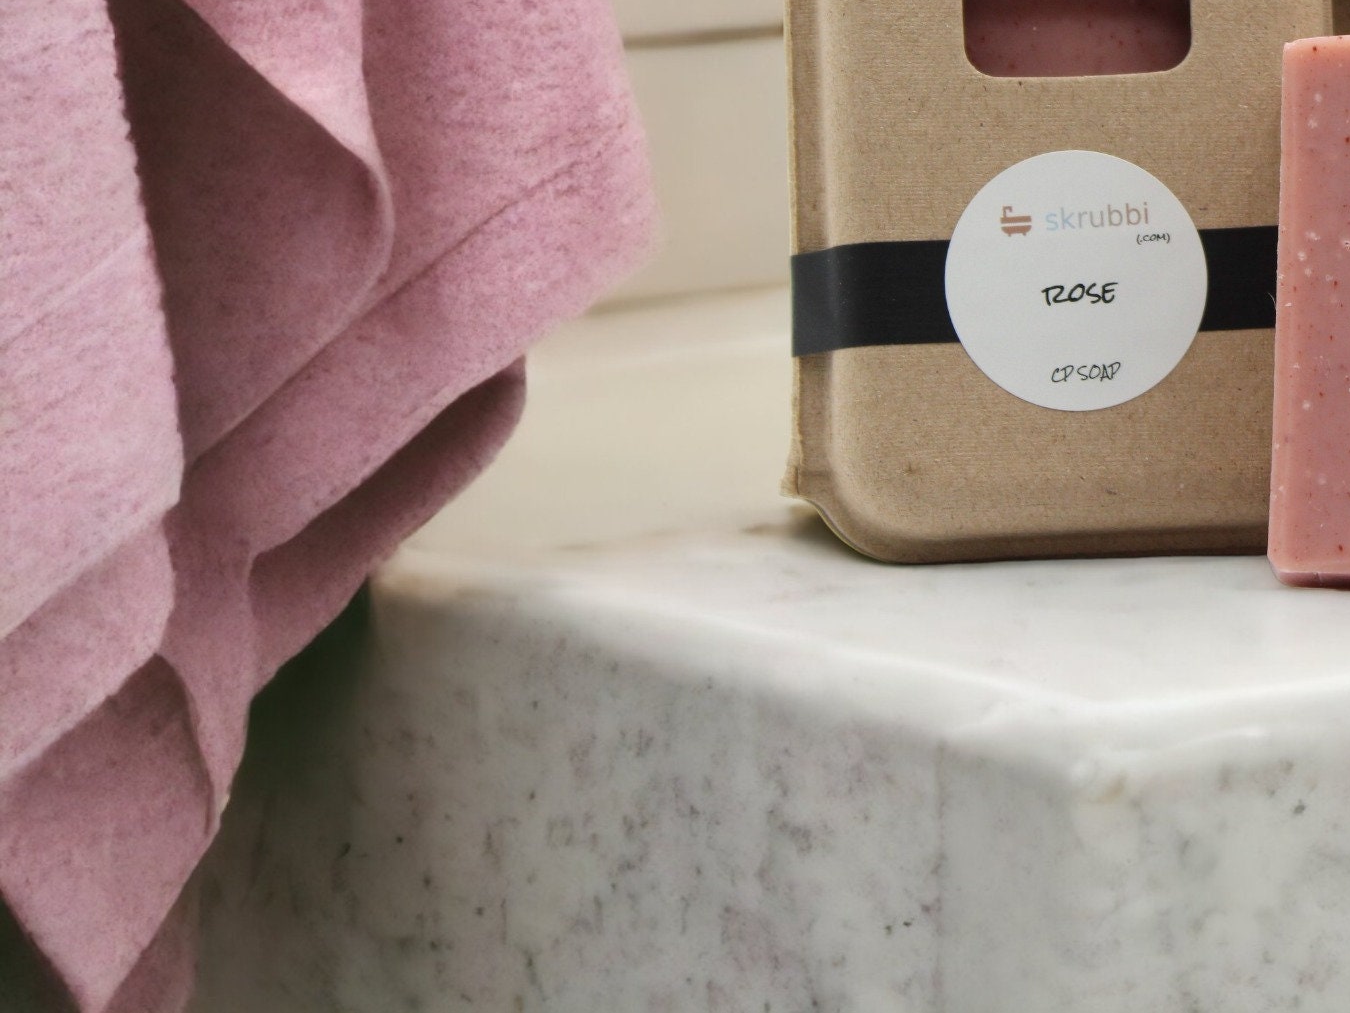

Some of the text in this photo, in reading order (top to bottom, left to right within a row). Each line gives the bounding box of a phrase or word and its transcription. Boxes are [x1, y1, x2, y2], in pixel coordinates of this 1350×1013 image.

[1045, 201, 1150, 231] skrubbi
[1041, 281, 1119, 306] ROSE
[1076, 361, 1121, 382] SOAP
